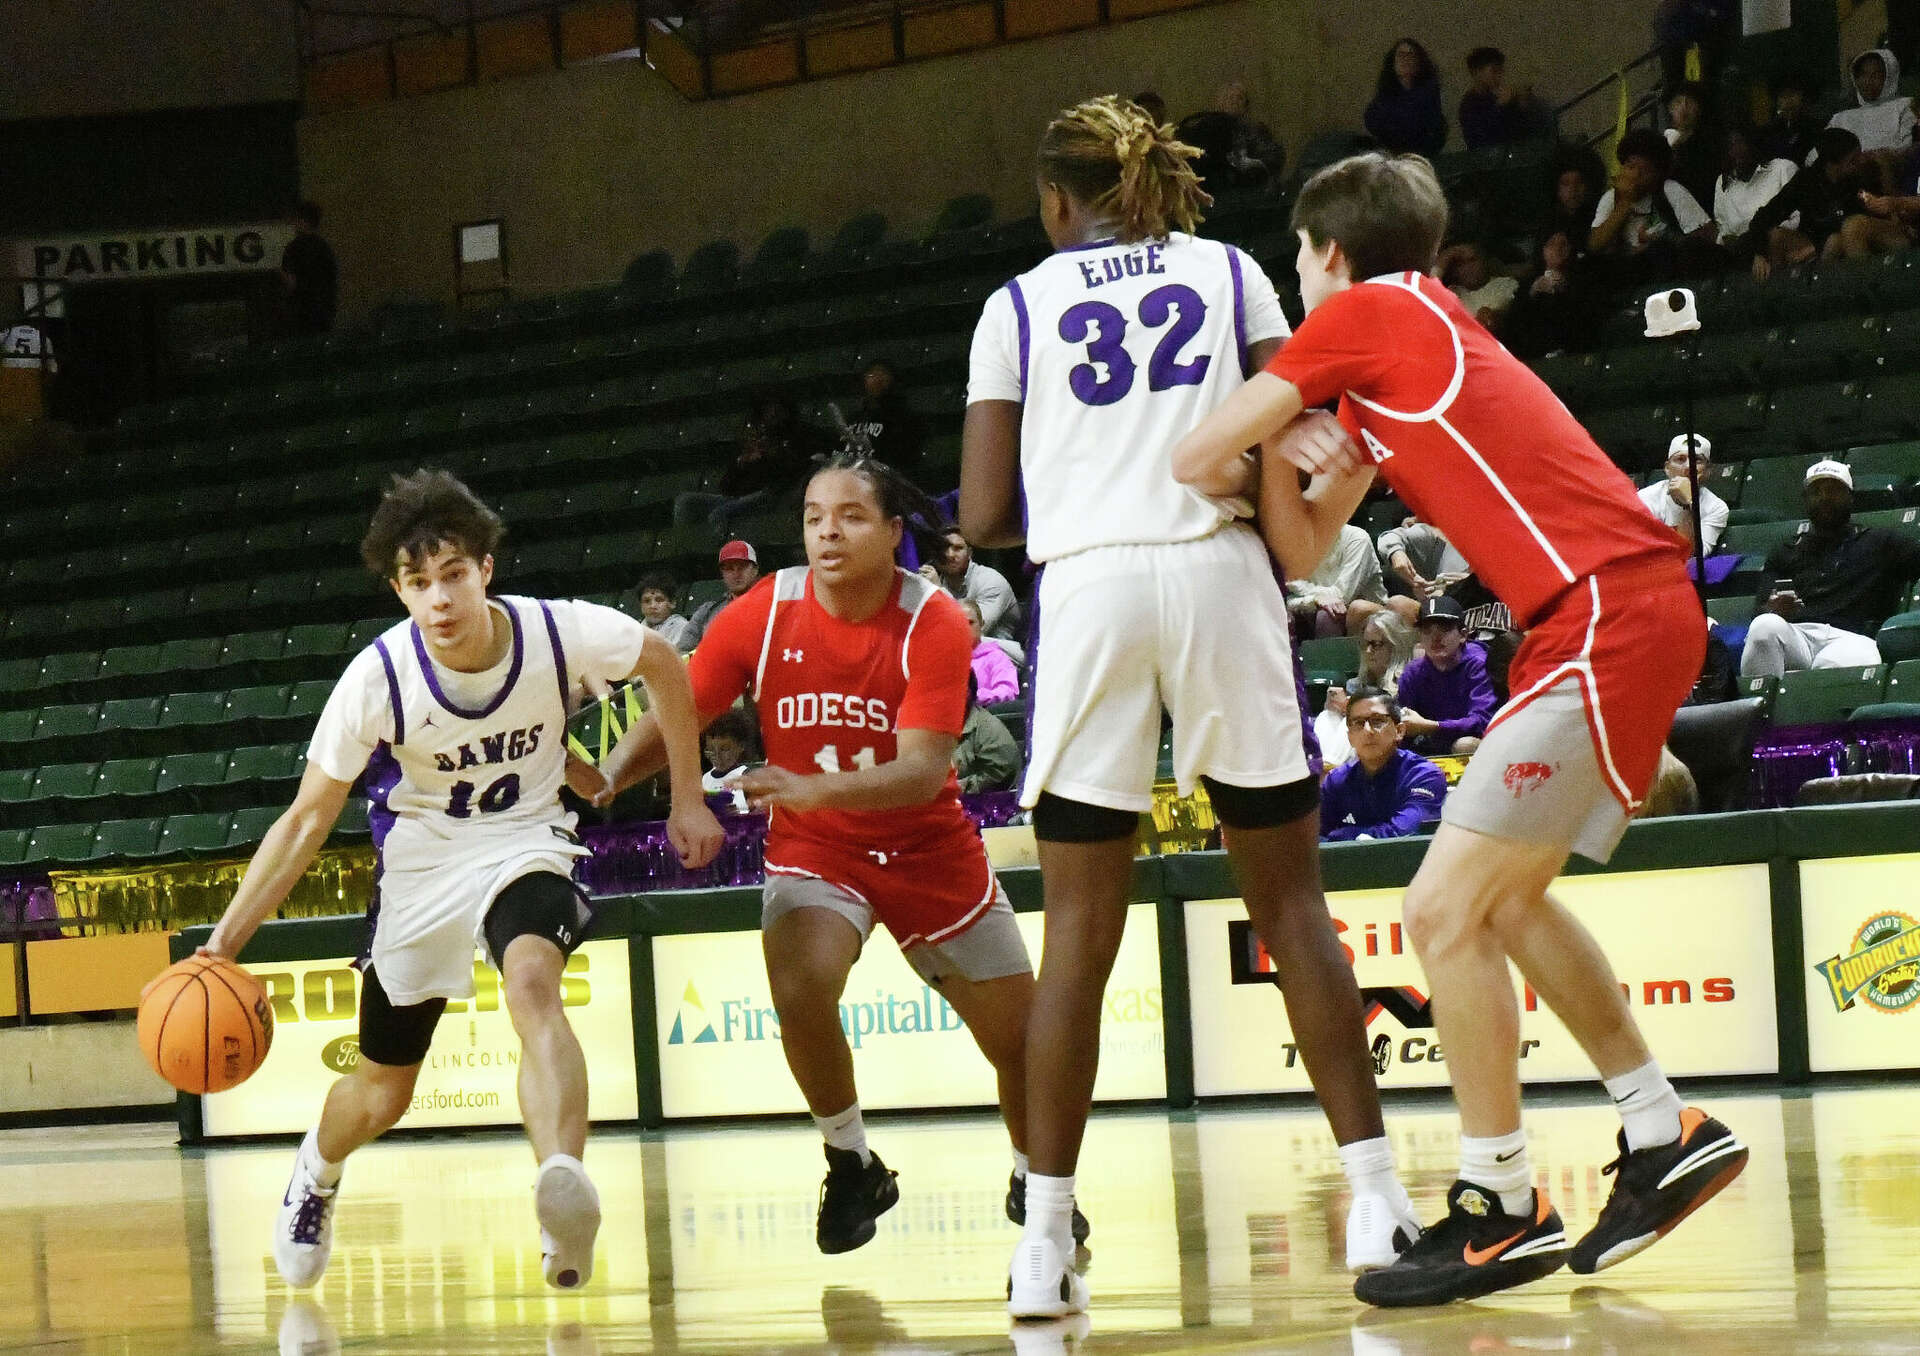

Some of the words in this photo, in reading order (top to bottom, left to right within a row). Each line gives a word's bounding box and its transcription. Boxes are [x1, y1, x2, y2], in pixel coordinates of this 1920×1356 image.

[34, 231, 265, 277] PARKING
[1078, 244, 1166, 289] EDGE
[1058, 283, 1212, 406] 32
[777, 692, 897, 735] ODESS
[444, 773, 521, 819] 10
[556, 924, 572, 945] 10
[1862, 916, 1900, 943] WORLD'S
[721, 997, 782, 1043] Firs
[837, 984, 934, 1050] apital
[1103, 987, 1162, 1023] xas
[431, 1049, 518, 1070] LINCOLN
[405, 1087, 500, 1116] ersford.com
